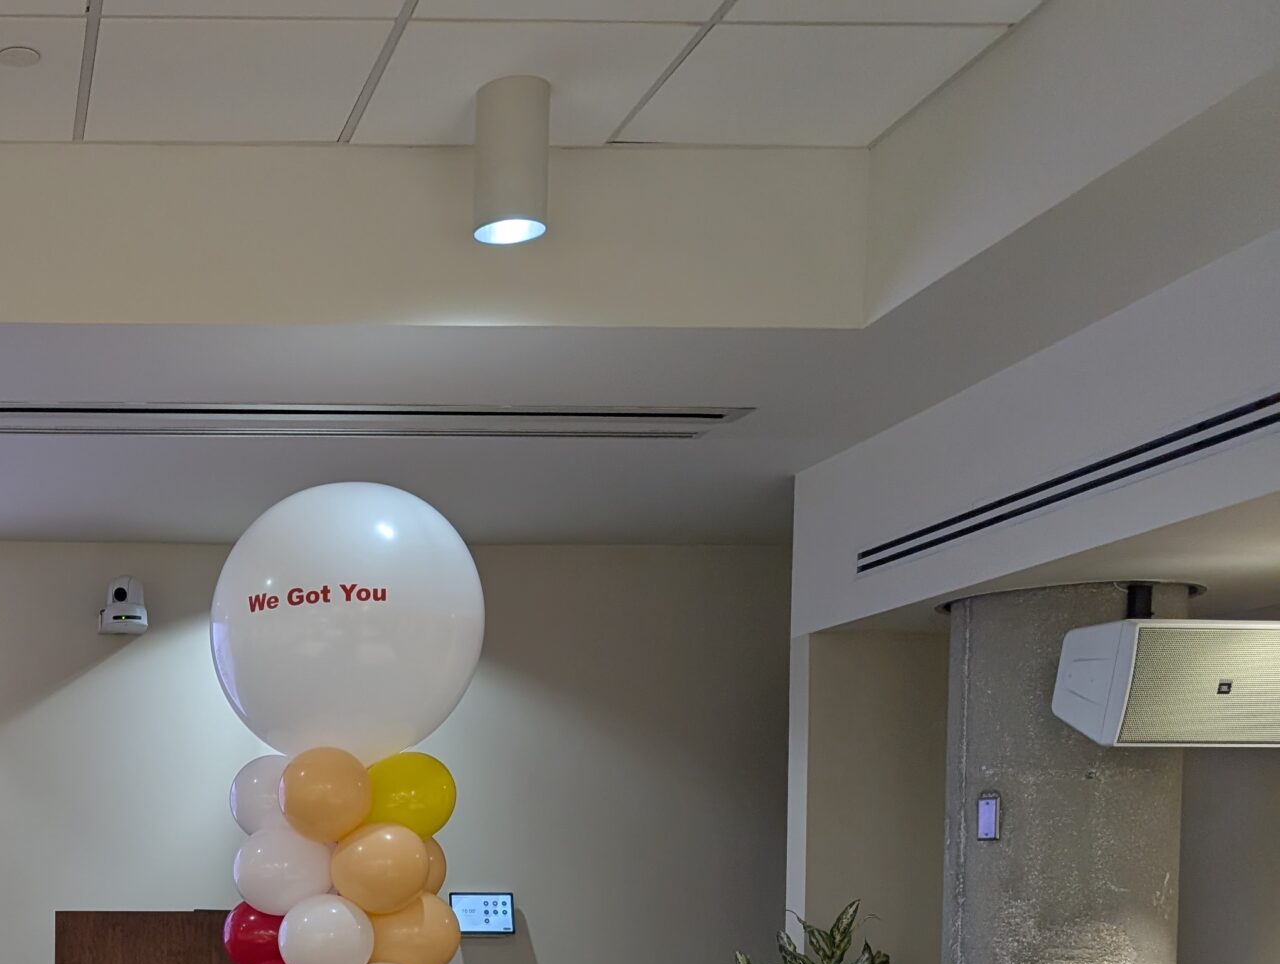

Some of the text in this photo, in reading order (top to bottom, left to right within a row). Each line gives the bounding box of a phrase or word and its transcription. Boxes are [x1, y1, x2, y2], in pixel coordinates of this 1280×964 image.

[248, 584, 387, 613] We Got You
